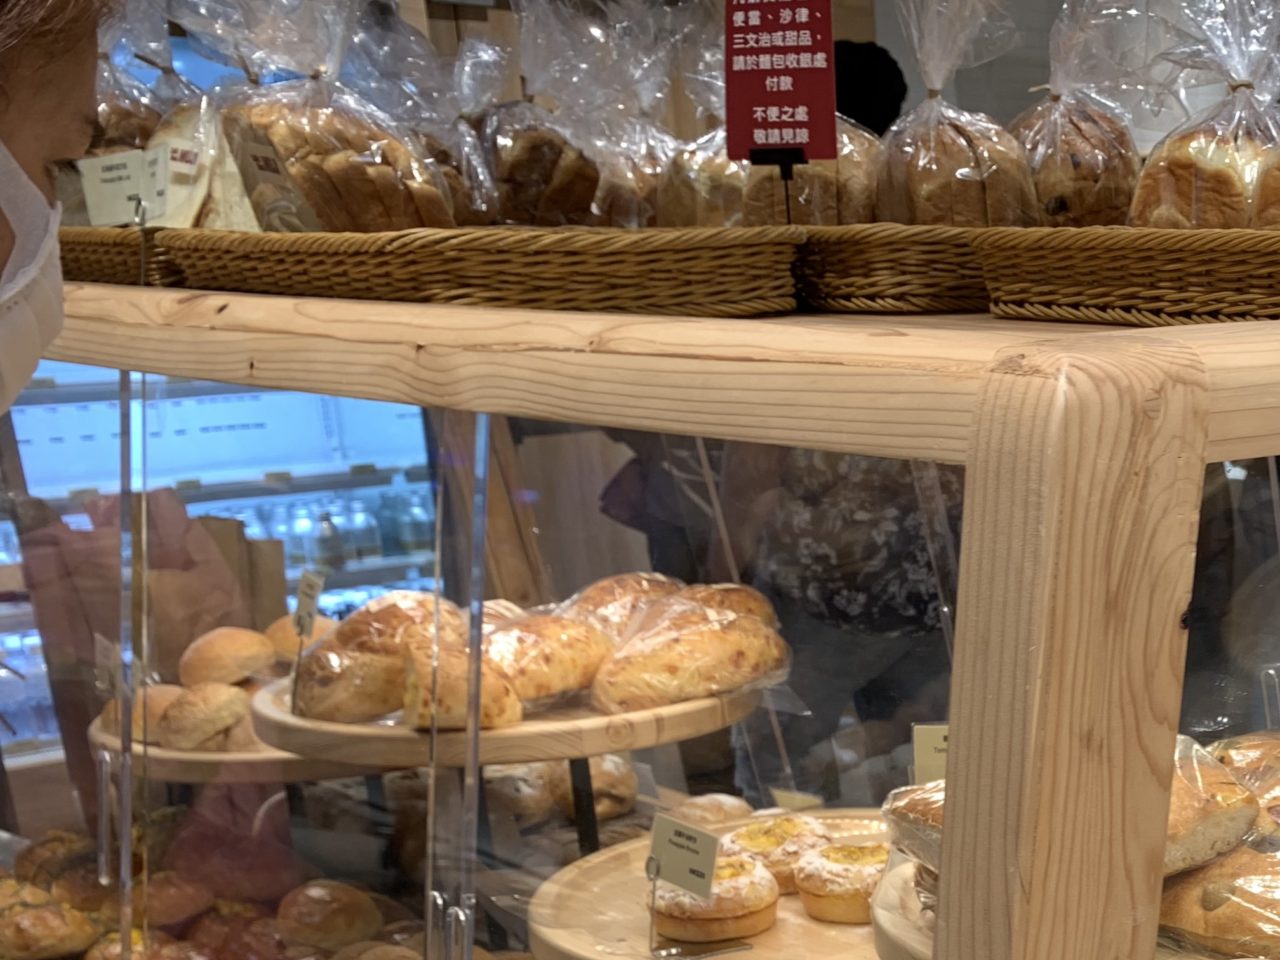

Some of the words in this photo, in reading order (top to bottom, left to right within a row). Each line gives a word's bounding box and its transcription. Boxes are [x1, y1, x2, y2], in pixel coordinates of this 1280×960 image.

[765, 75, 794, 92] 付款
[752, 105, 809, 122] 不便之處
[753, 128, 810, 144] 敬請見諒
